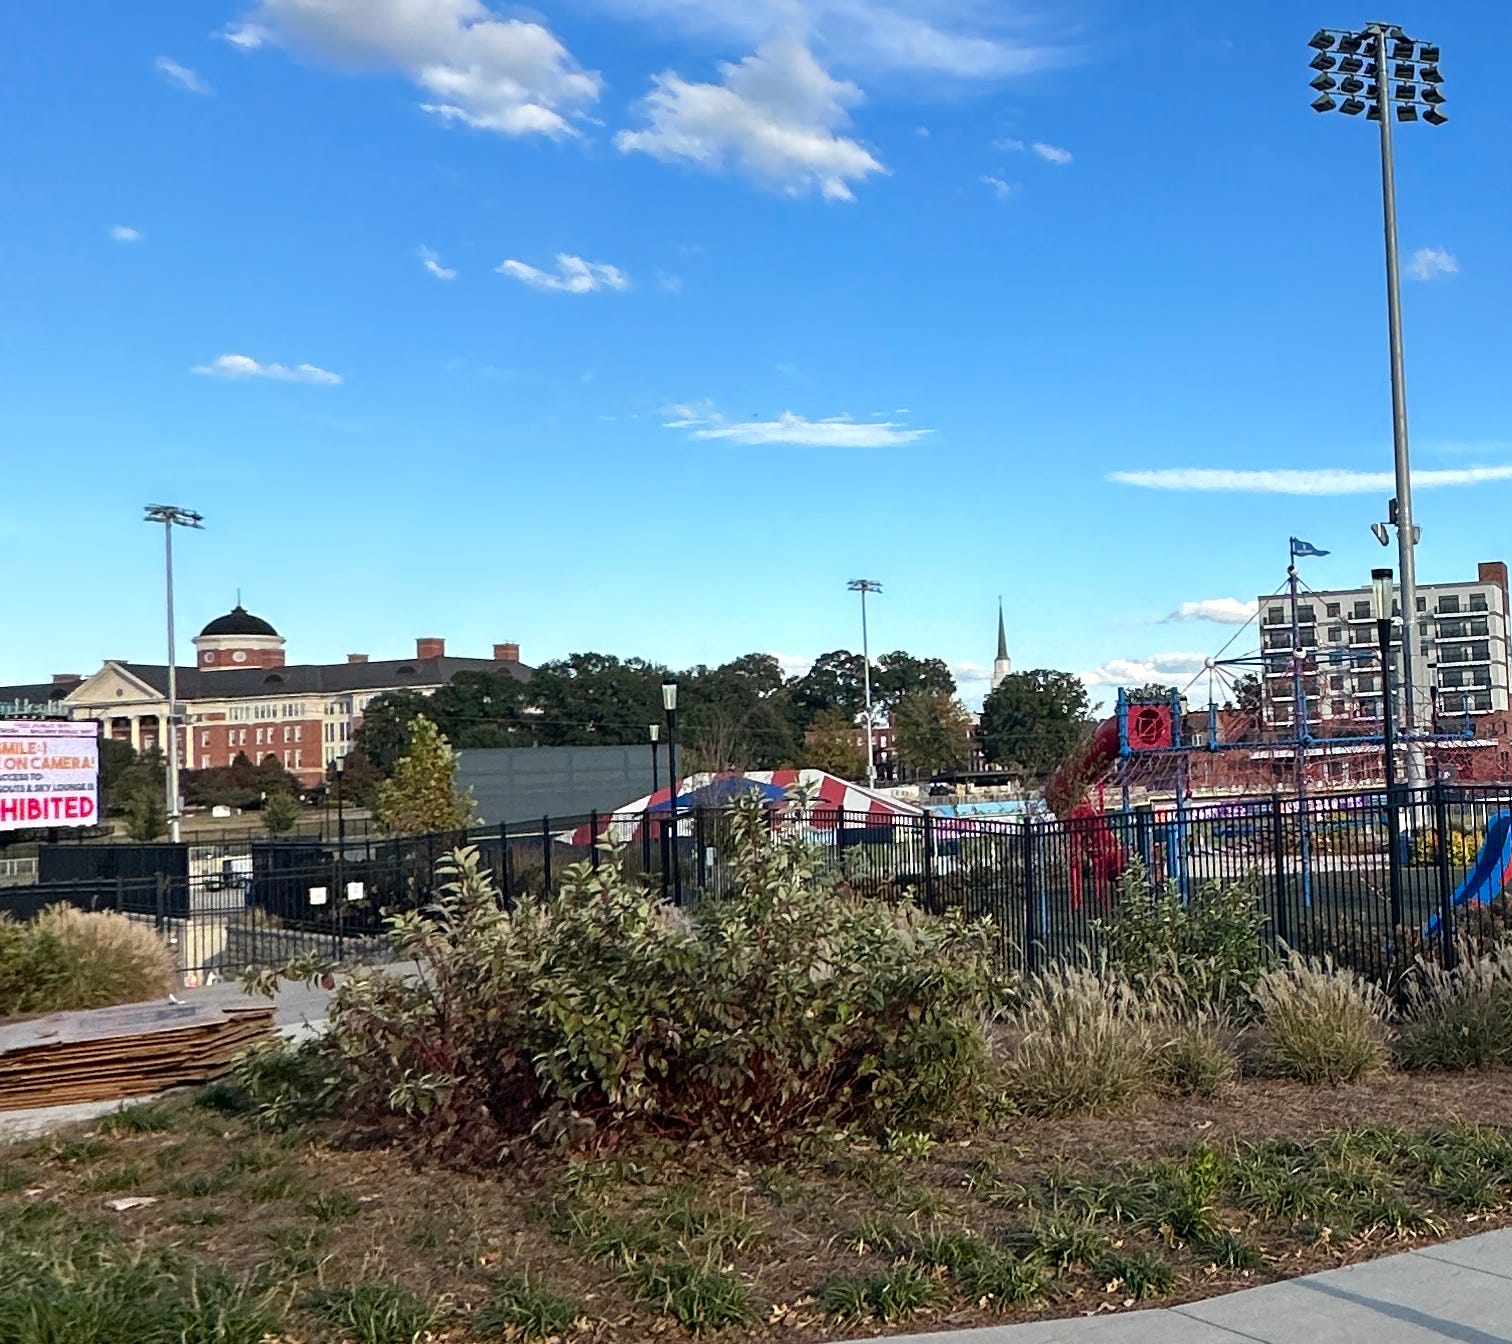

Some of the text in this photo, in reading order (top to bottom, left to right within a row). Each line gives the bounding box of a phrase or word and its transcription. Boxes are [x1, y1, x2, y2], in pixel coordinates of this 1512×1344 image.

[4, 756, 95, 770] ON CAMERA!
[0, 796, 95, 821] HIBITED
